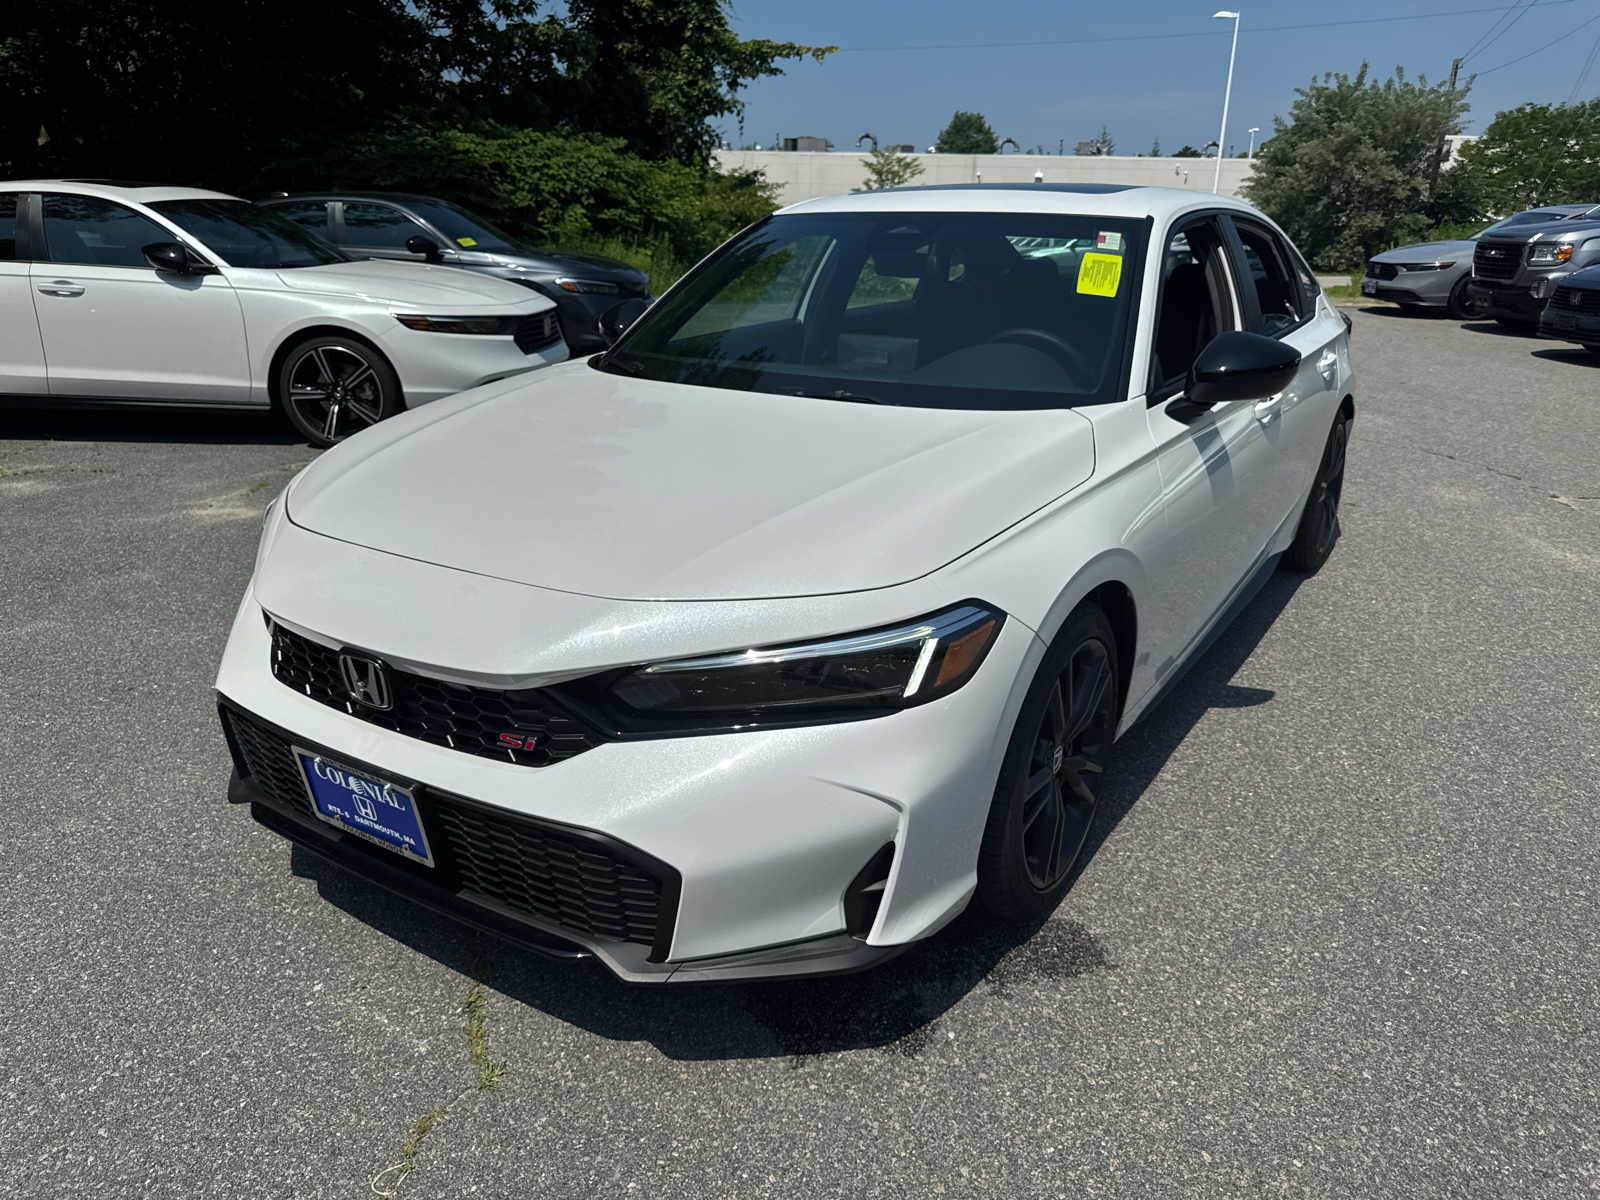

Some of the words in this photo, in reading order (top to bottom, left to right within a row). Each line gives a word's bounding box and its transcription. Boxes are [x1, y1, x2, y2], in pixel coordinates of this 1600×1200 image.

[497, 733, 537, 751] Si
[354, 814, 403, 841] DARTMOUTH,
[403, 834, 416, 846] MA
